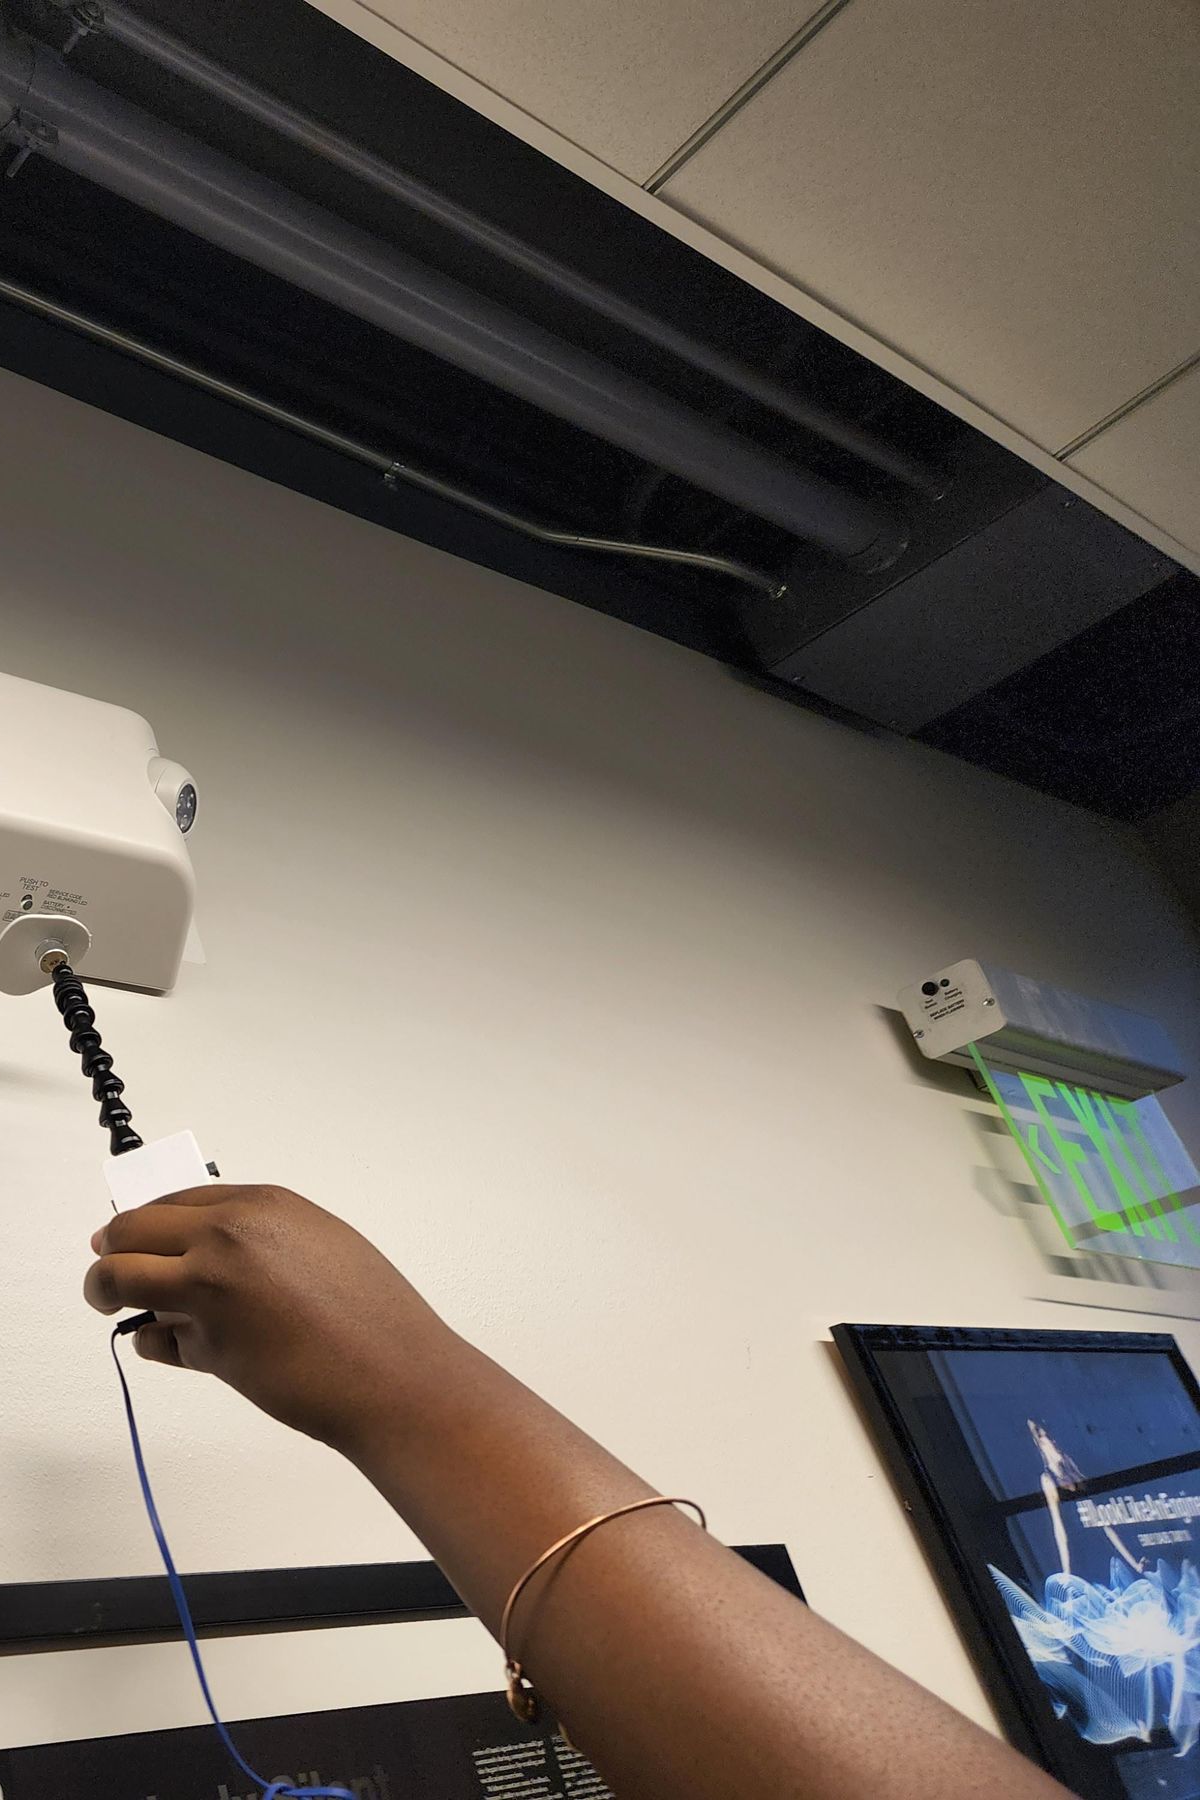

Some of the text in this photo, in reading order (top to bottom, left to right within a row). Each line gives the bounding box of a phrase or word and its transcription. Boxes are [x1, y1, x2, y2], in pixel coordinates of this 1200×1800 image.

[19, 876, 38, 886] PUSH
[22, 884, 39, 892] TEST
[43, 900, 64, 908] BATTERY
[1017, 1071, 1200, 1247] EXIT
